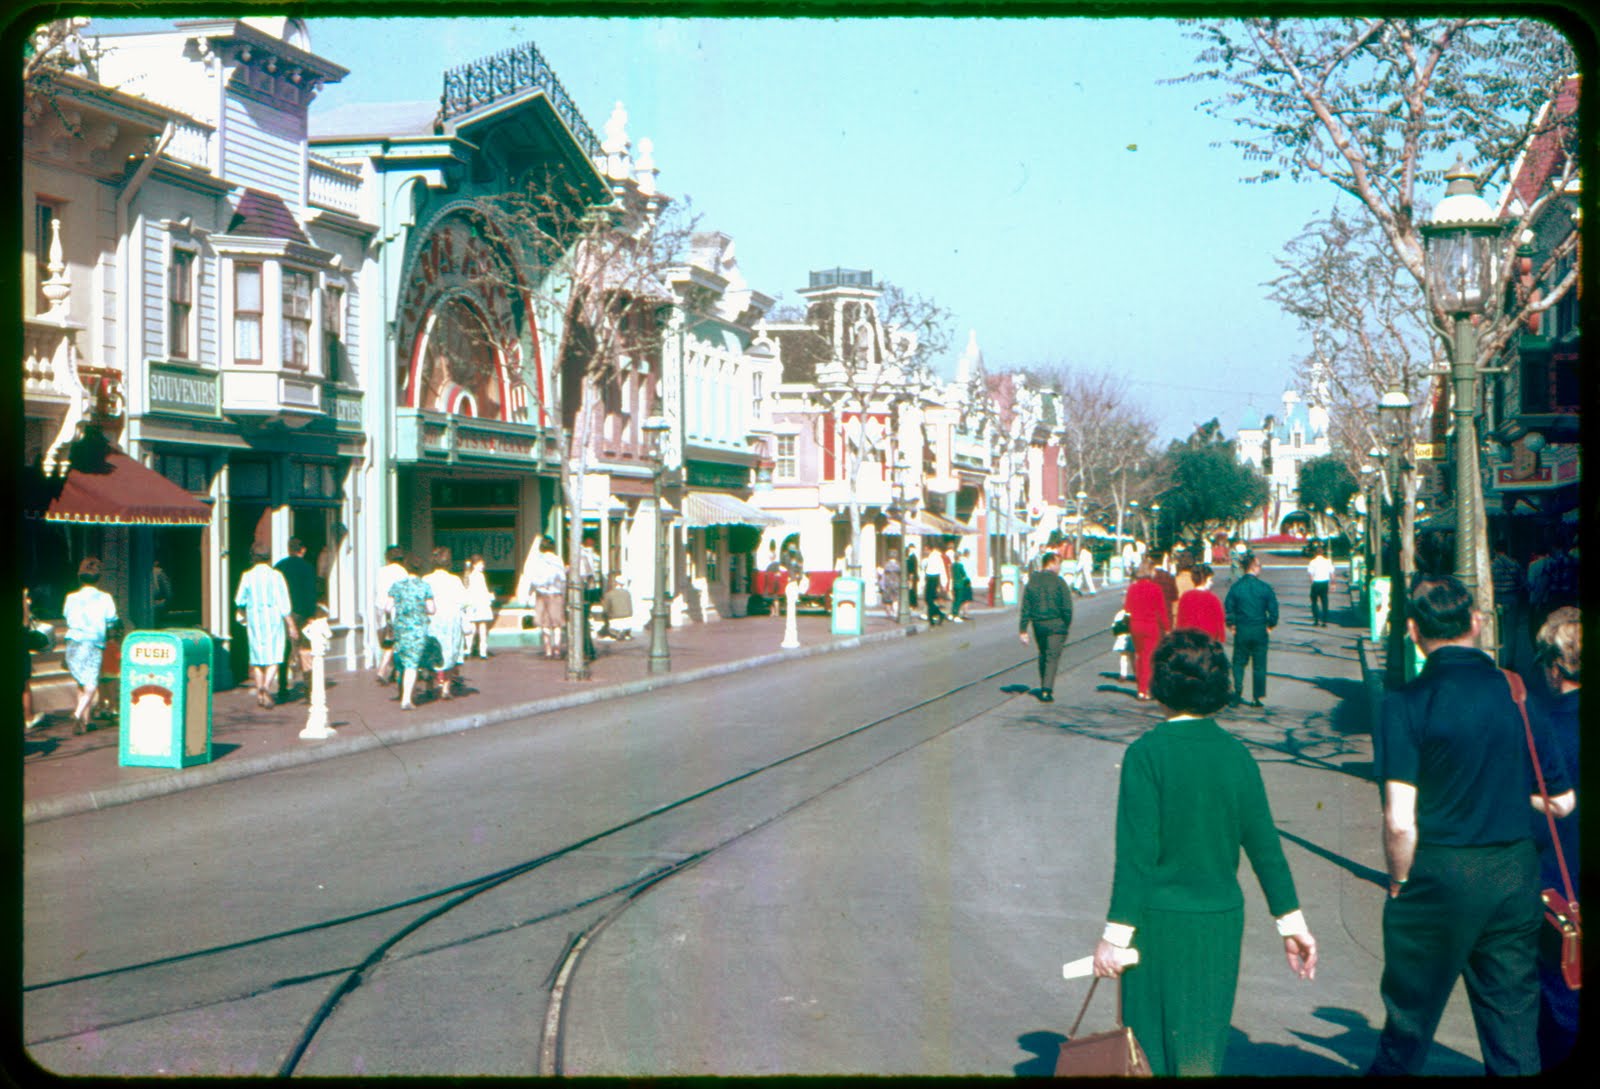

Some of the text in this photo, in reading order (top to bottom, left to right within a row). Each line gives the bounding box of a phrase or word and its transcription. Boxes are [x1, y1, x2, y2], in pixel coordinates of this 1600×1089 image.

[151, 374, 216, 406] SOUVENIRS
[1415, 447, 1446, 457] Koda
[135, 647, 170, 658] PUSH
